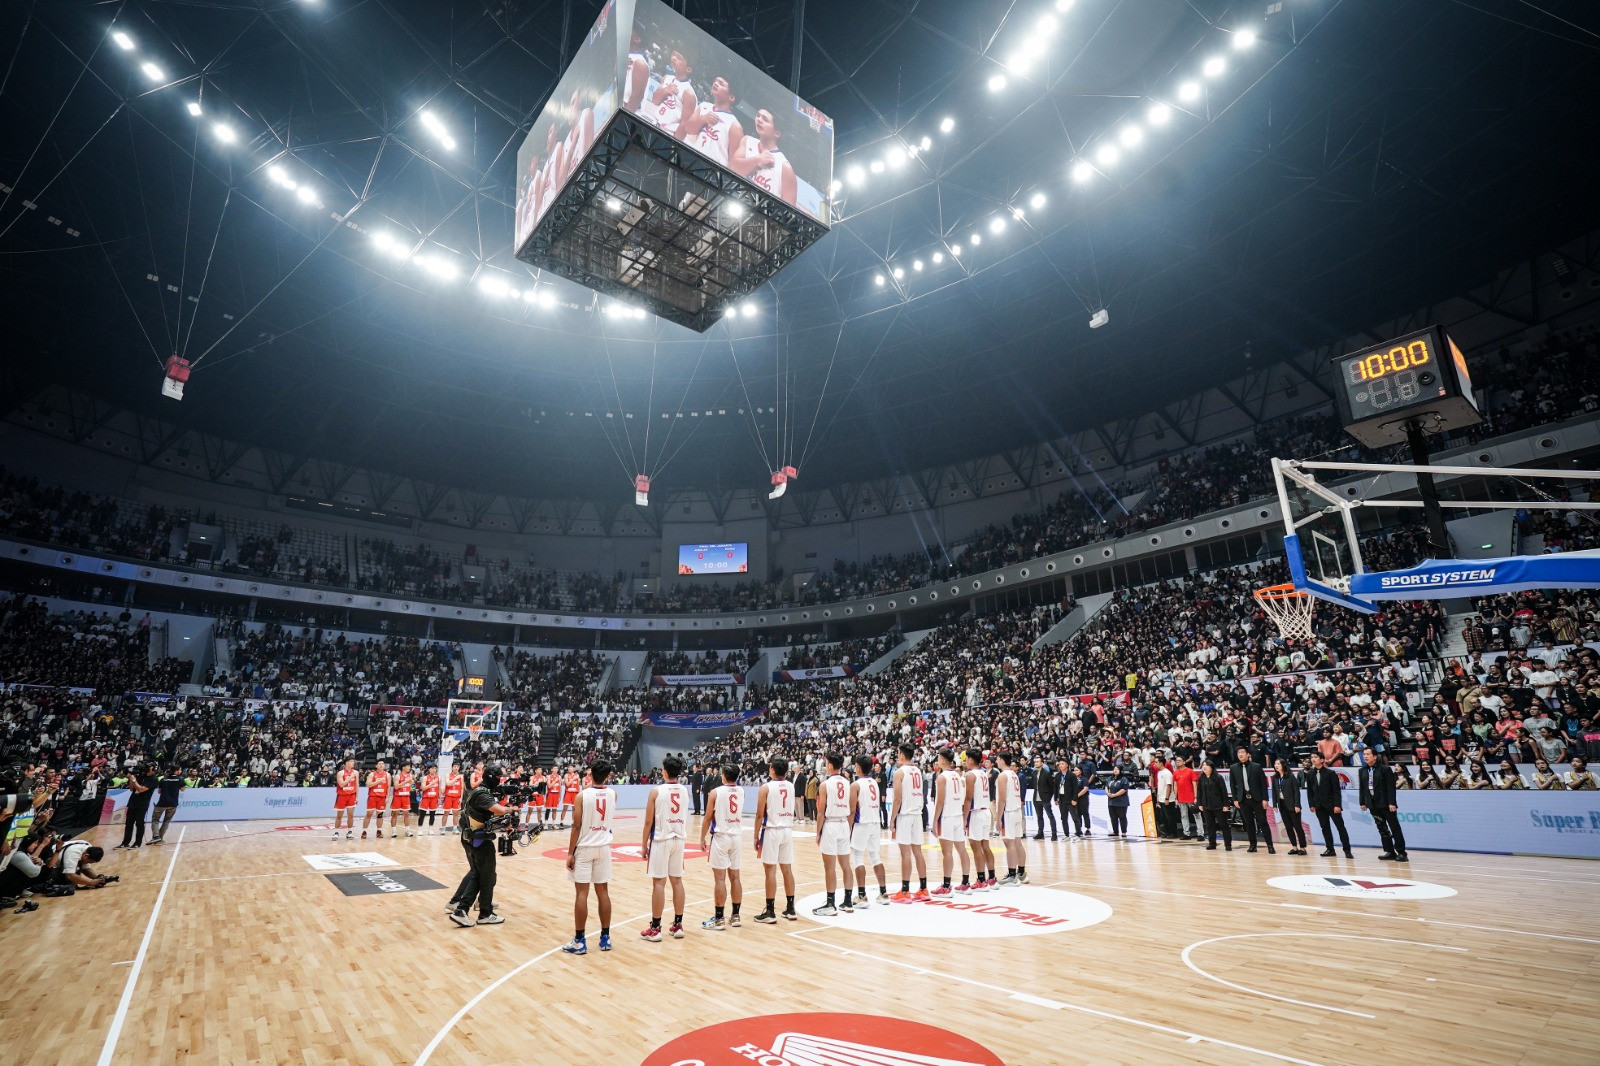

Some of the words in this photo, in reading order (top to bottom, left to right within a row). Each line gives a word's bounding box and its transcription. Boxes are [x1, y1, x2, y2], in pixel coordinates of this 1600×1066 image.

[1359, 340, 1429, 379] 10:00
[1381, 574, 1429, 586] SPORT
[1430, 569, 1496, 585] SYSTEM
[909, 771, 921, 789] 10
[952, 777, 960, 794] 11
[981, 776, 988, 792] 12
[779, 788, 788, 808] 7
[836, 781, 844, 800] 8
[869, 784, 877, 801] 9
[179, 799, 223, 808] umparan
[596, 798, 607, 821] 4
[670, 793, 680, 814] 5
[729, 793, 738, 814] 6
[1530, 809, 1585, 834] Super
[972, 905, 1070, 926] Day
